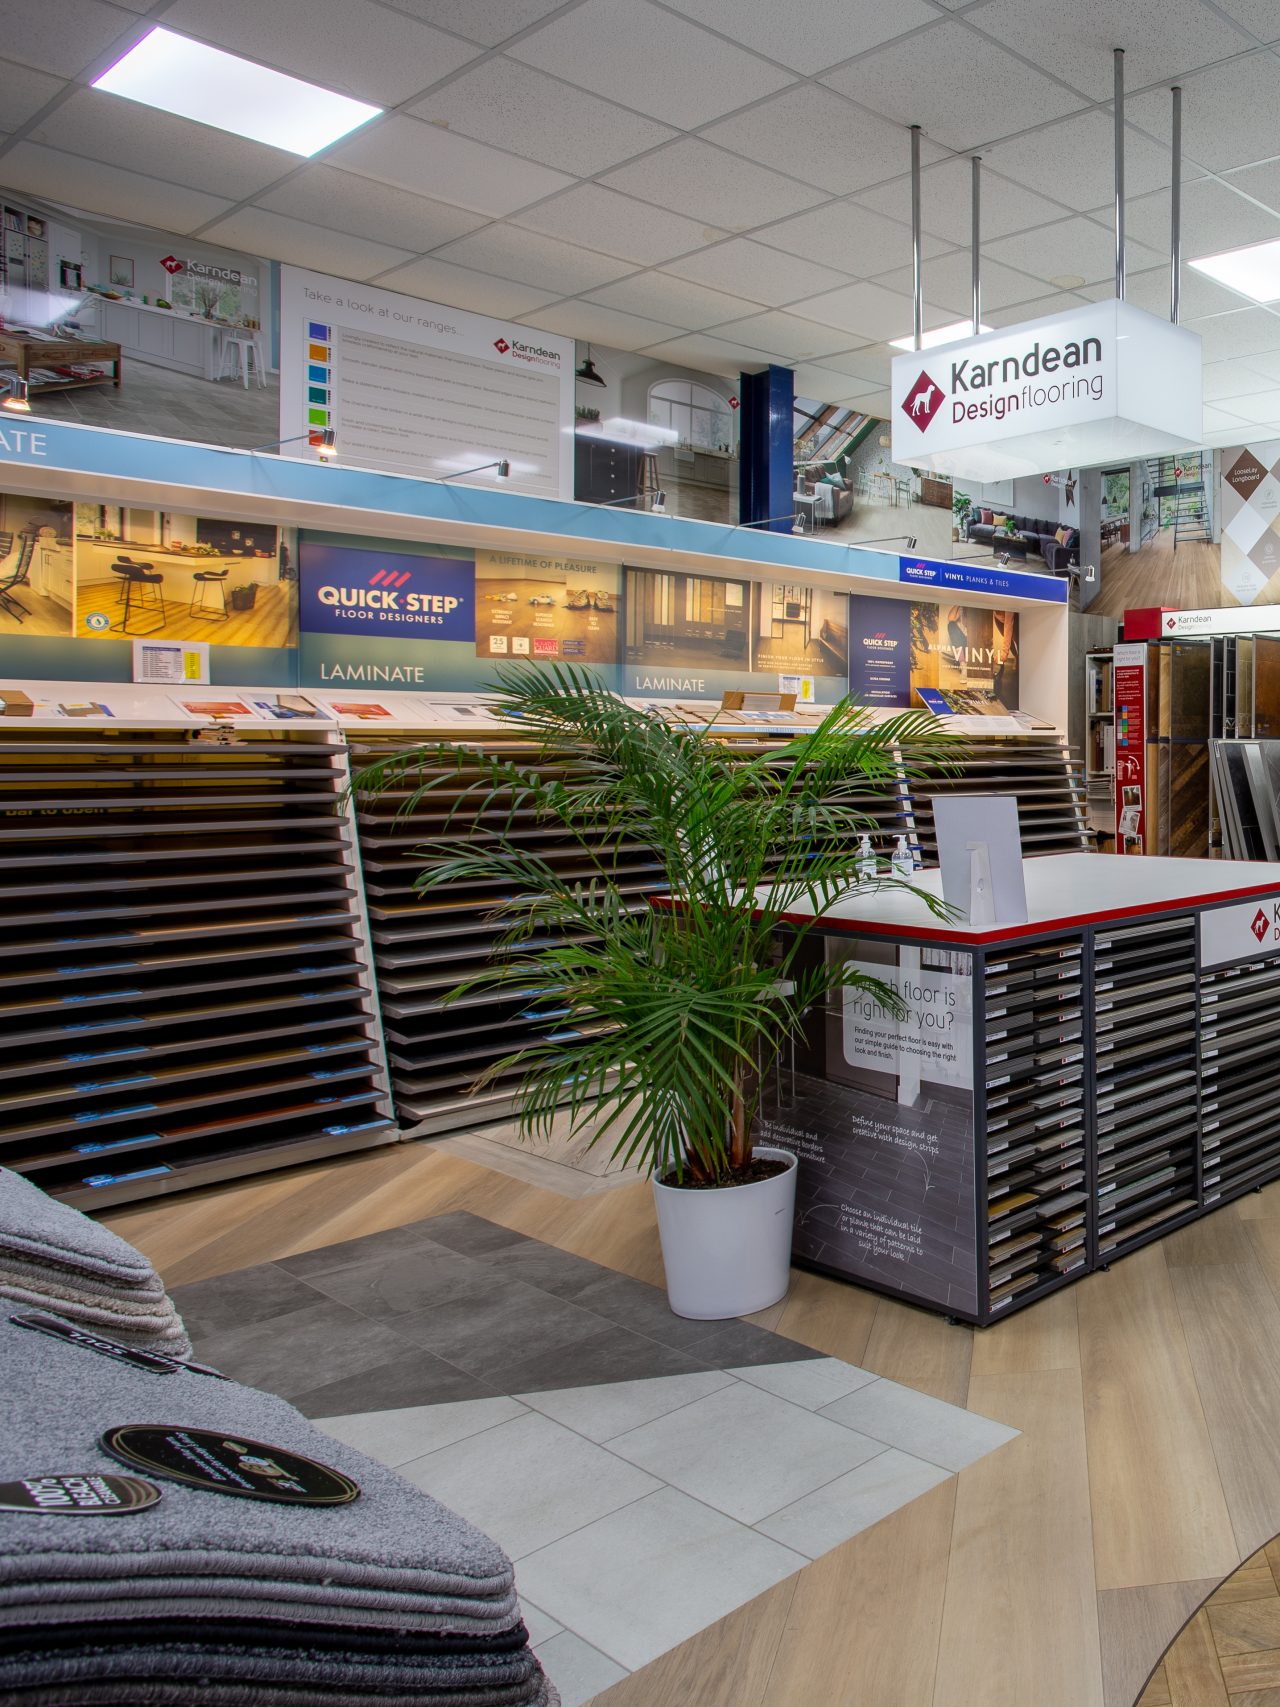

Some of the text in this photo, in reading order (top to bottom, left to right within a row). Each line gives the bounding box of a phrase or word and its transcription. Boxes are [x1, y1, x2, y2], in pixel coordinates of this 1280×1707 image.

[187, 259, 257, 286] Karndean
[303, 287, 332, 304] Take
[336, 298, 344, 307] a
[347, 298, 375, 315] look
[378, 307, 390, 318] at
[393, 312, 414, 323] our
[512, 340, 561, 360] Karndean
[512, 351, 561, 369] Designflooring
[951, 336, 1102, 395] Karndean
[952, 375, 1103, 424] Designflooring
[1232, 474, 1260, 484] Longboard
[499, 556, 538, 568] LIFETIME
[539, 559, 554, 569] OF
[554, 561, 598, 575] PLEASURE
[944, 572, 964, 581] VINYL
[966, 575, 988, 585] PLANKS
[995, 579, 1009, 588] TILES
[335, 608, 444, 625] FLOOR DESIGNERS
[1178, 614, 1212, 624] Karndean
[928, 644, 951, 652] ALPHA
[952, 646, 1004, 665] VINYL
[320, 663, 425, 683] LAMINATE
[635, 676, 705, 692] LAMINATE
[904, 980, 940, 1004] floor
[944, 986, 956, 1007] is
[853, 999, 887, 1021] right
[916, 1011, 955, 1031] you?
[854, 1026, 874, 1037] Finding
[874, 1030, 887, 1039] your
[887, 1032, 907, 1042] perfect
[908, 1036, 921, 1045] floor
[927, 1040, 941, 1049] easy
[941, 1042, 954, 1051] with
[864, 1038, 882, 1048] simple
[883, 1041, 899, 1051] guide
[906, 1046, 932, 1058] choosing
[932, 1050, 942, 1058] the
[942, 1052, 957, 1062] right
[854, 1046, 866, 1054] look
[867, 1048, 878, 1057] and
[852, 1115, 938, 1144] Define your space and get
[852, 1127, 939, 1156] creative with design strips
[840, 1203, 923, 1235] Choose an individual tile
[849, 1216, 869, 1229] plank
[869, 1223, 884, 1233] that
[884, 1228, 898, 1237] can
[898, 1230, 906, 1240] be
[907, 1233, 921, 1244] laid
[840, 1221, 849, 1232] in
[854, 1229, 878, 1246] variety
[879, 1235, 887, 1247] of
[887, 1239, 915, 1254] patterns
[916, 1247, 924, 1256] to
[858, 1239, 872, 1250] suit
[873, 1244, 889, 1256] your
[21, 1478, 74, 1507] 100%
[60, 1477, 103, 1506] BLEACH
[86, 1476, 121, 1504] CLEANABLE
